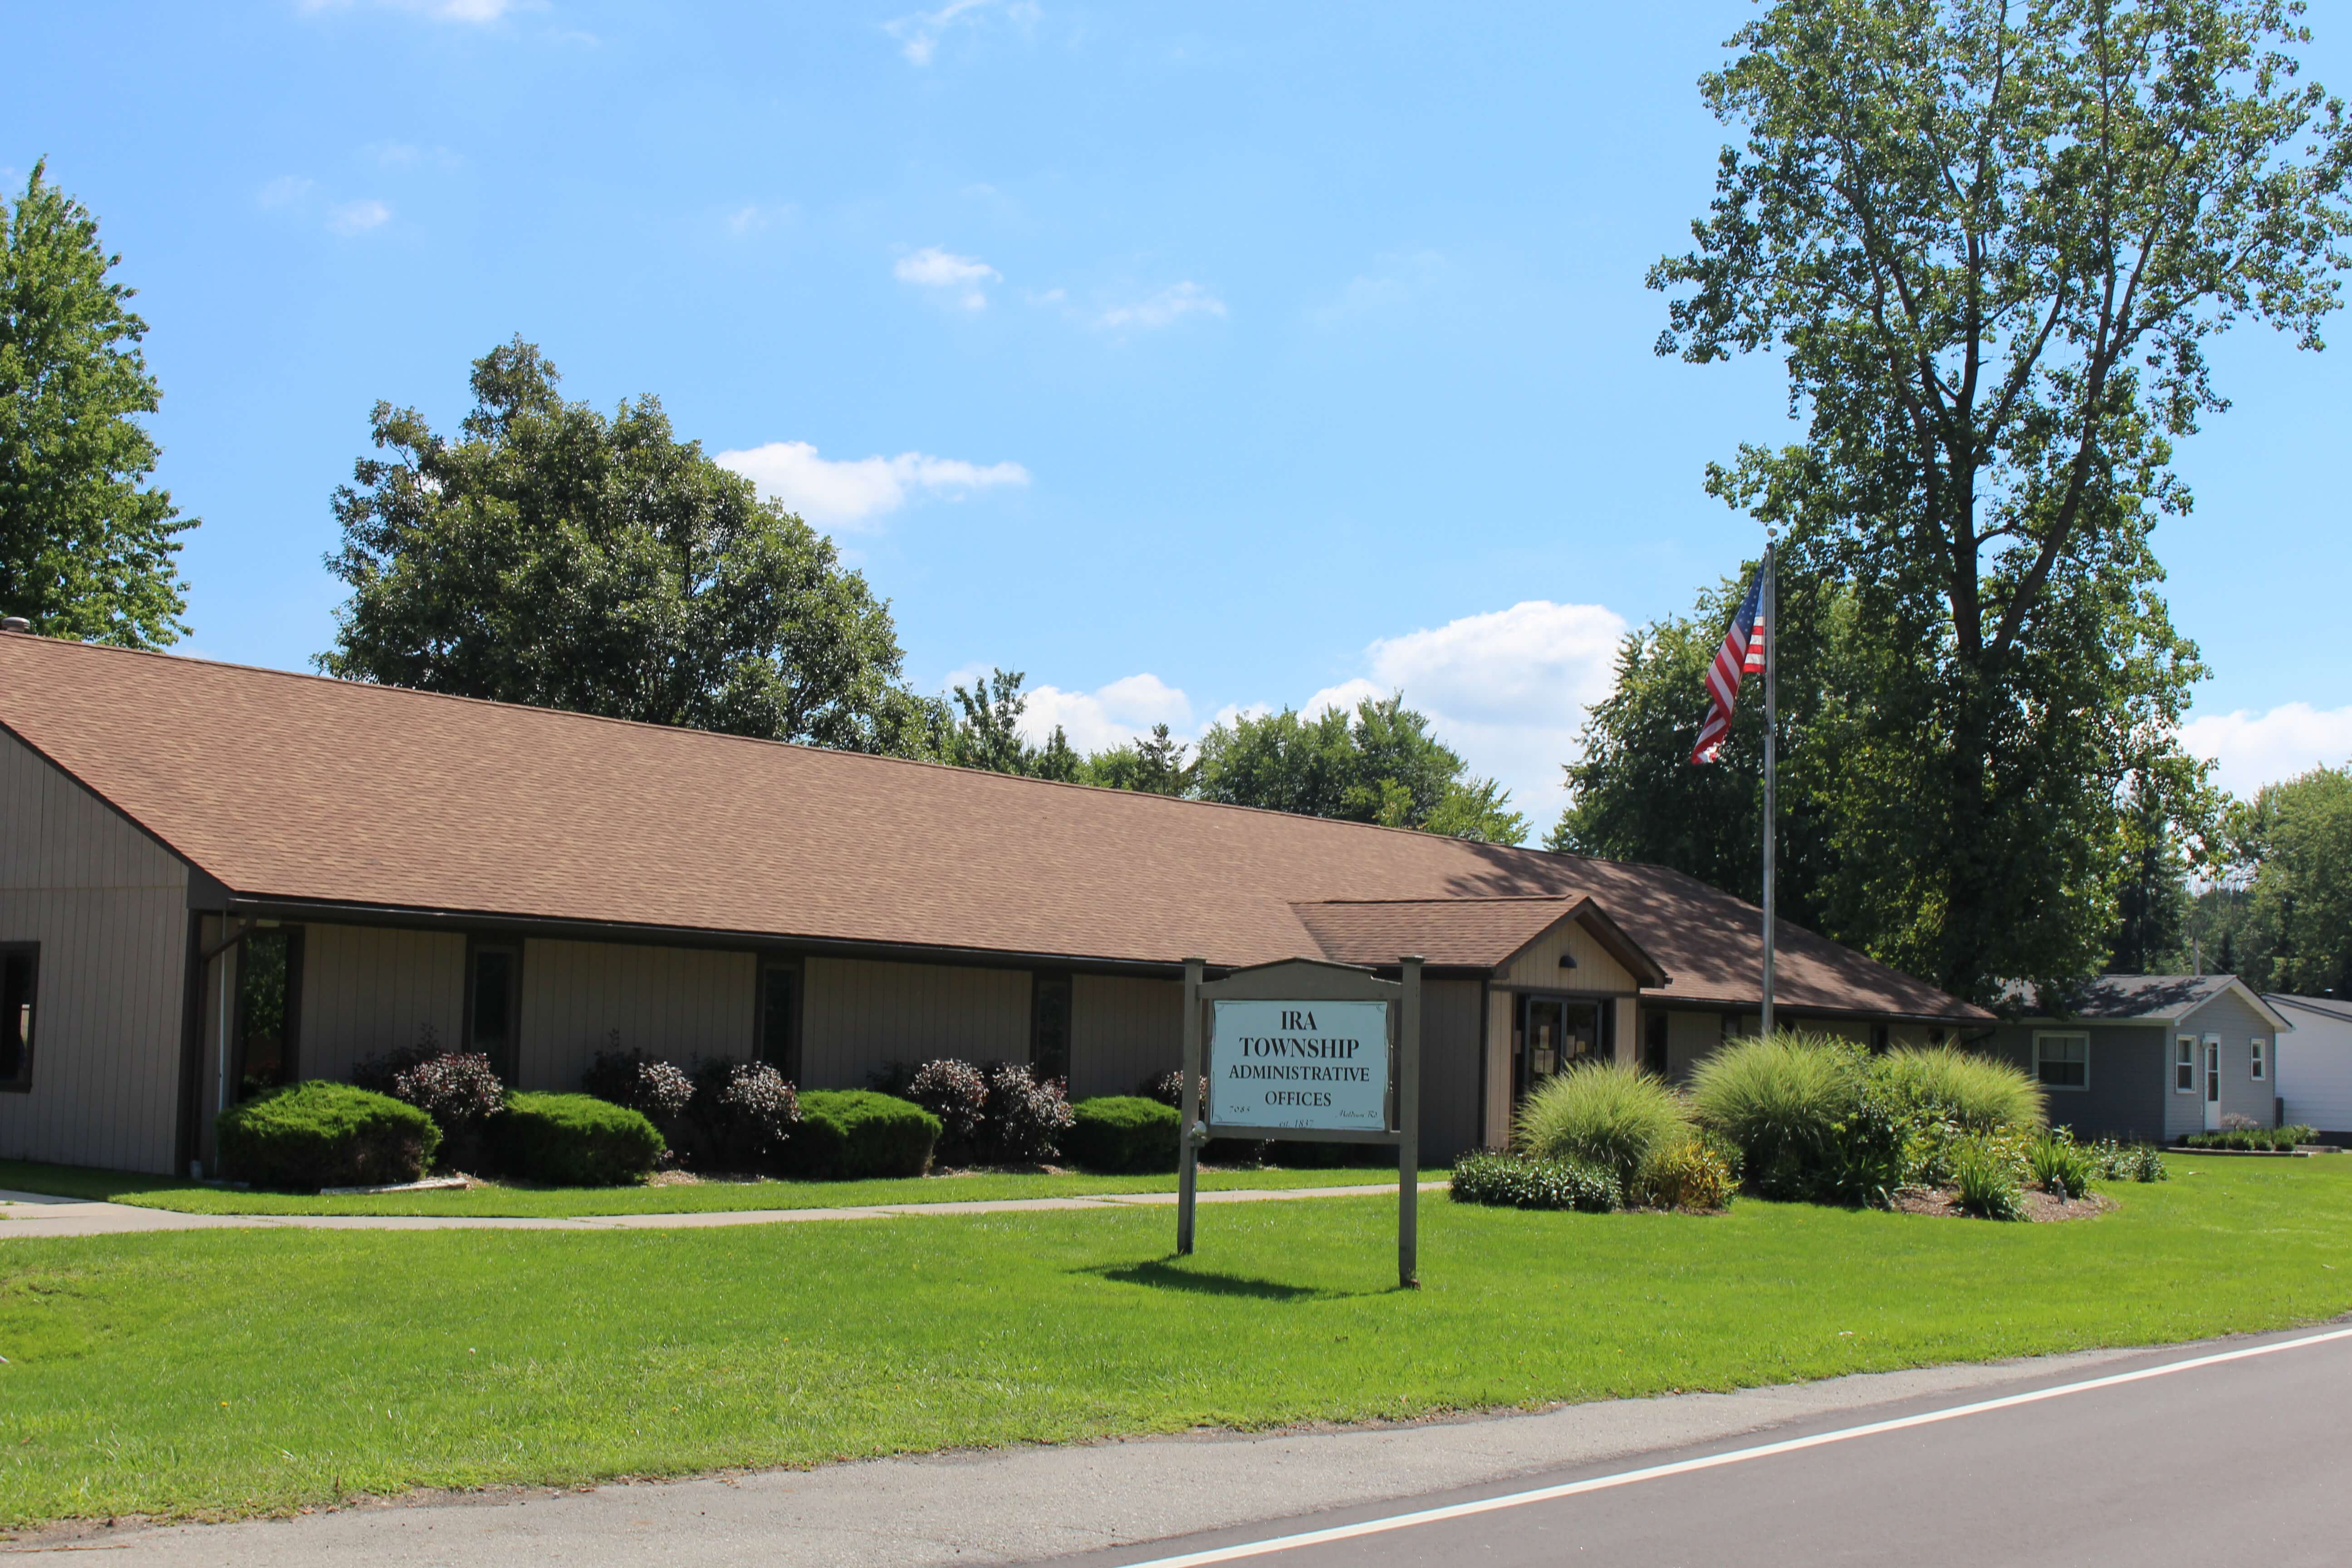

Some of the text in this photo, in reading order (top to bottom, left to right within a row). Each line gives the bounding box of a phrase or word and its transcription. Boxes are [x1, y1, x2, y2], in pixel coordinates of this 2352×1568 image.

[1281, 1011, 1317, 1030] IRA
[1239, 1038, 1359, 1058] TOWNSHIP
[1229, 1065, 1370, 1082] ADMINISTRATIVE
[1265, 1091, 1332, 1106] OFFICES
